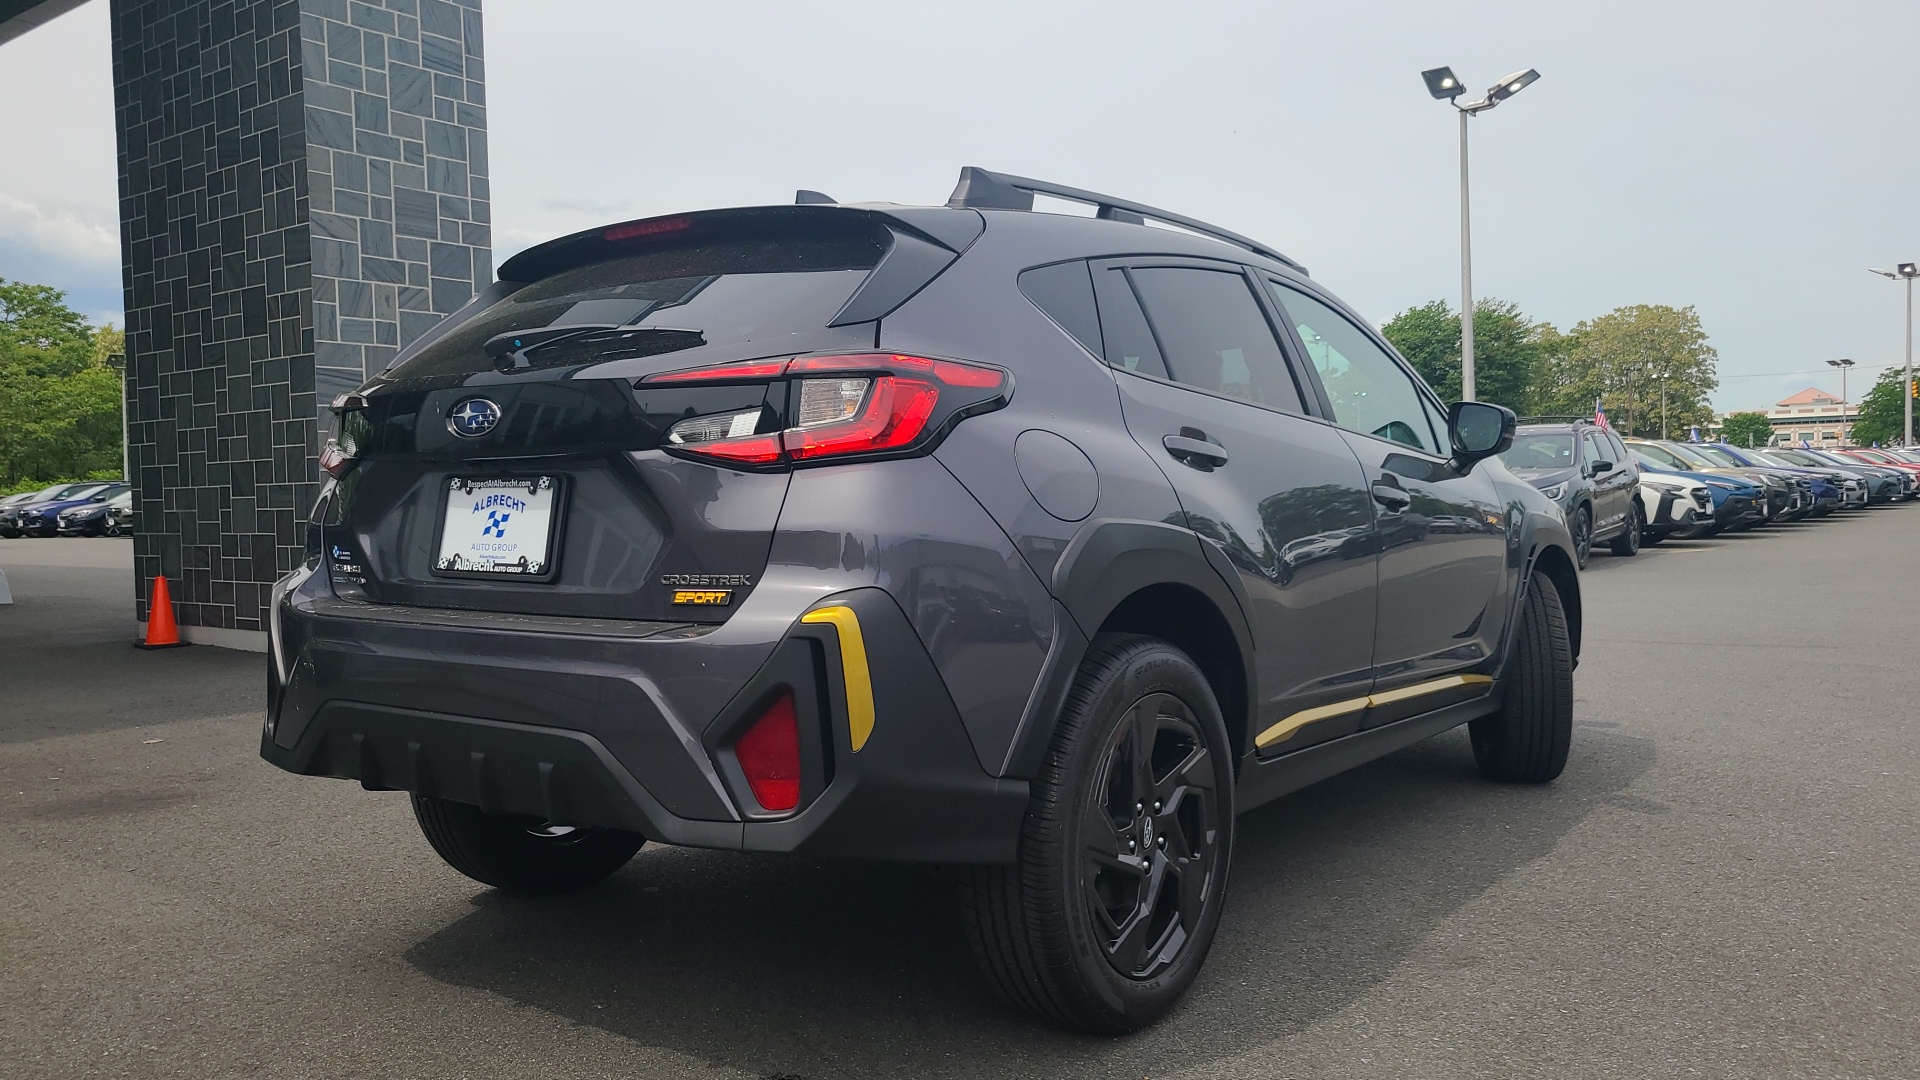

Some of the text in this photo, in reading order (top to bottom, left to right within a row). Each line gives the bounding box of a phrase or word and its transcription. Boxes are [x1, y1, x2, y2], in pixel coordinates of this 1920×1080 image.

[467, 479, 532, 489] RespectAtAlbrecht.com
[472, 494, 527, 514] ALBRECHT
[470, 543, 518, 552] AUTO GROUP
[454, 558, 494, 572] Albrecht
[660, 574, 751, 586] CROSSTREK
[674, 592, 726, 603] SPORT
